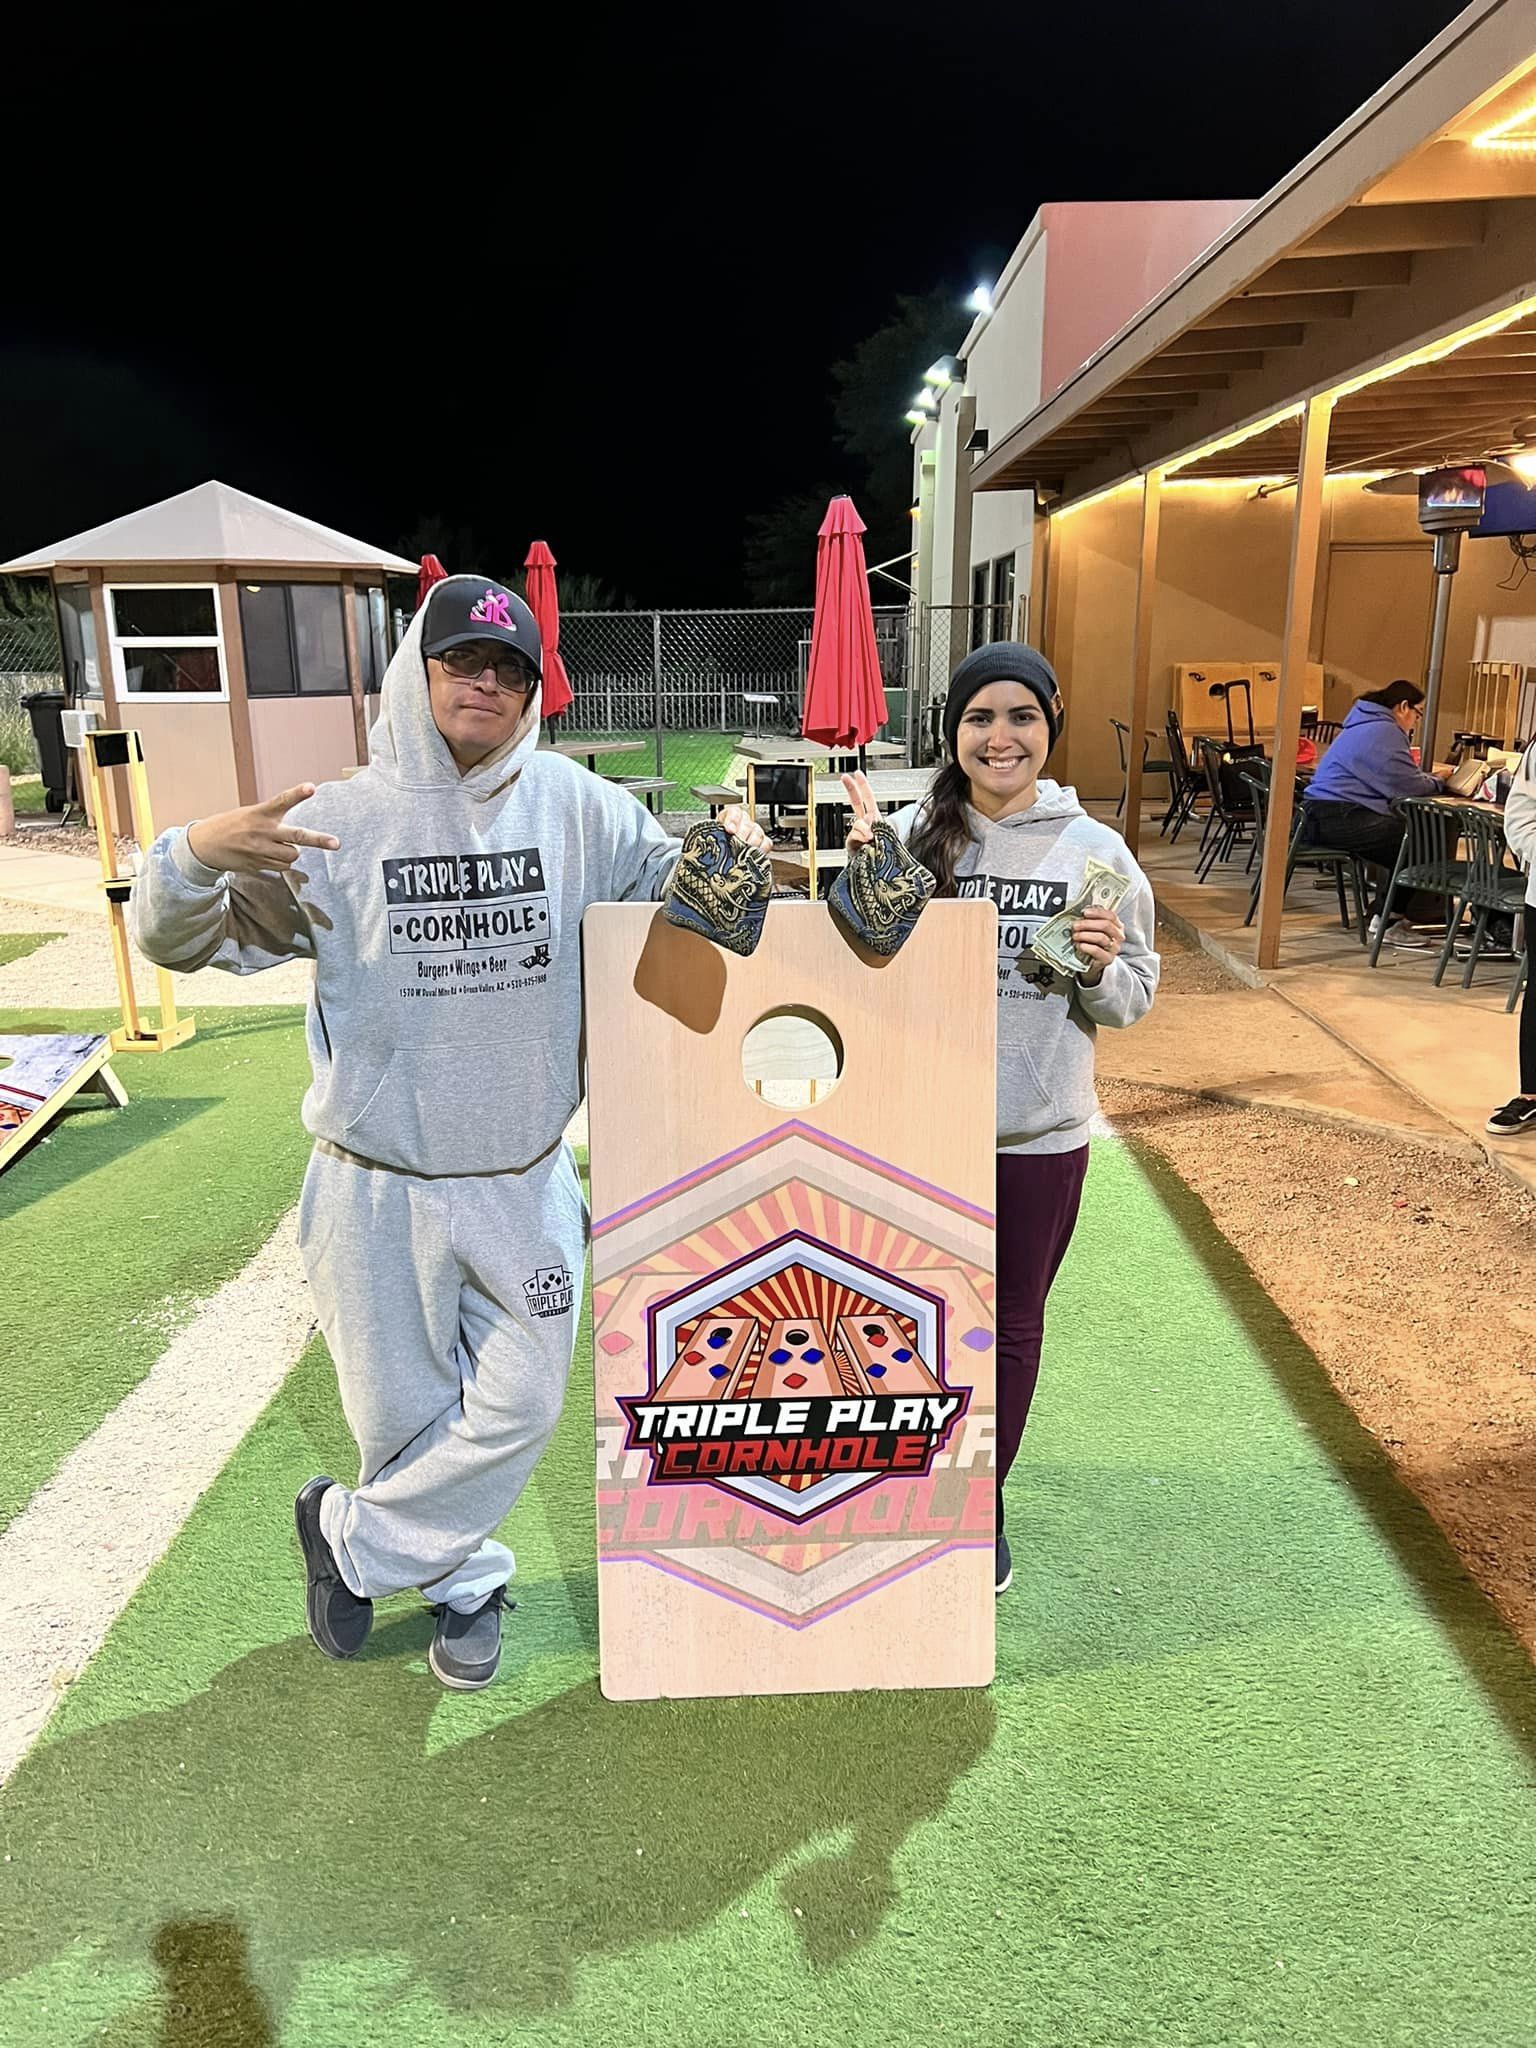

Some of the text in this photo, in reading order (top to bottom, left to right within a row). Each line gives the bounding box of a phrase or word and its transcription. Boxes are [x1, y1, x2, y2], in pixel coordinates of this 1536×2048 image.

[398, 855, 526, 896] TRIPLE PLAY
[1000, 884, 1053, 911] PLAY
[406, 906, 536, 943] CORNHOLE
[417, 956, 507, 980] Burgers Wings Beer
[528, 1295, 558, 1313] TRIPLE
[634, 1398, 958, 1438] TRIPLE PLAY
[662, 1435, 928, 1474] CORNHOLE
